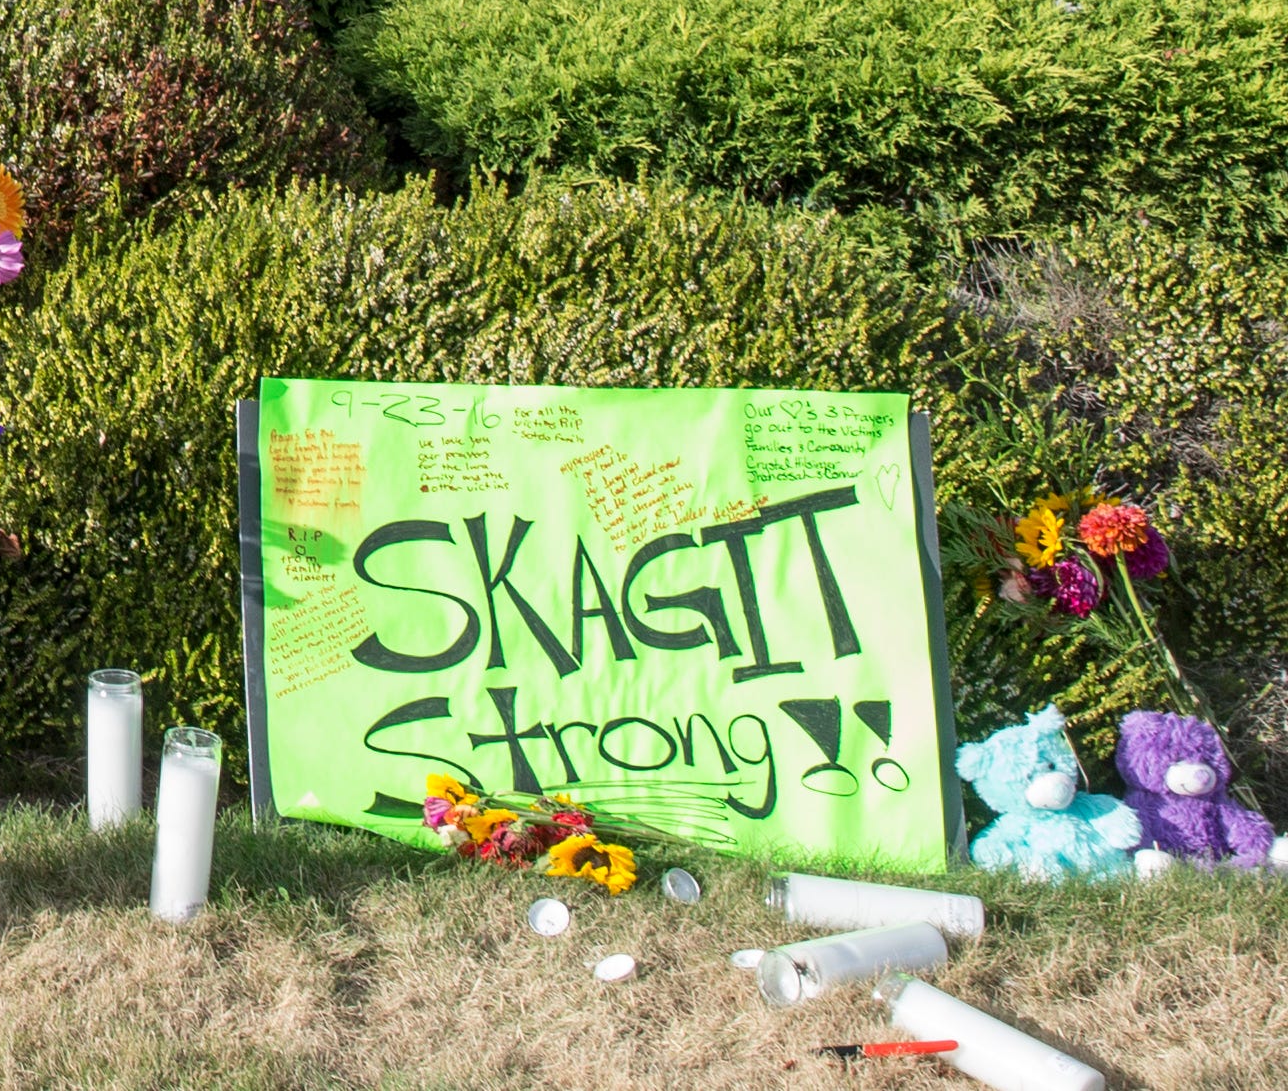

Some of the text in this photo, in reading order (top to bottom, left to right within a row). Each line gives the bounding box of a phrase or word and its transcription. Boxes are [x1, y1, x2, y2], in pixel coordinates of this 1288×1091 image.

[331, 392, 503, 430] 9-23-16
[537, 407, 554, 416] all
[559, 406, 579, 416] the
[744, 403, 775, 419] Our
[843, 406, 895, 427] Prayers
[744, 423, 762, 438] go
[768, 422, 792, 433] out
[799, 423, 812, 434] to
[817, 422, 836, 436] the
[442, 437, 465, 445] love
[442, 463, 461, 471] the
[484, 472, 504, 480] the
[351, 484, 862, 681] SKAGIT
